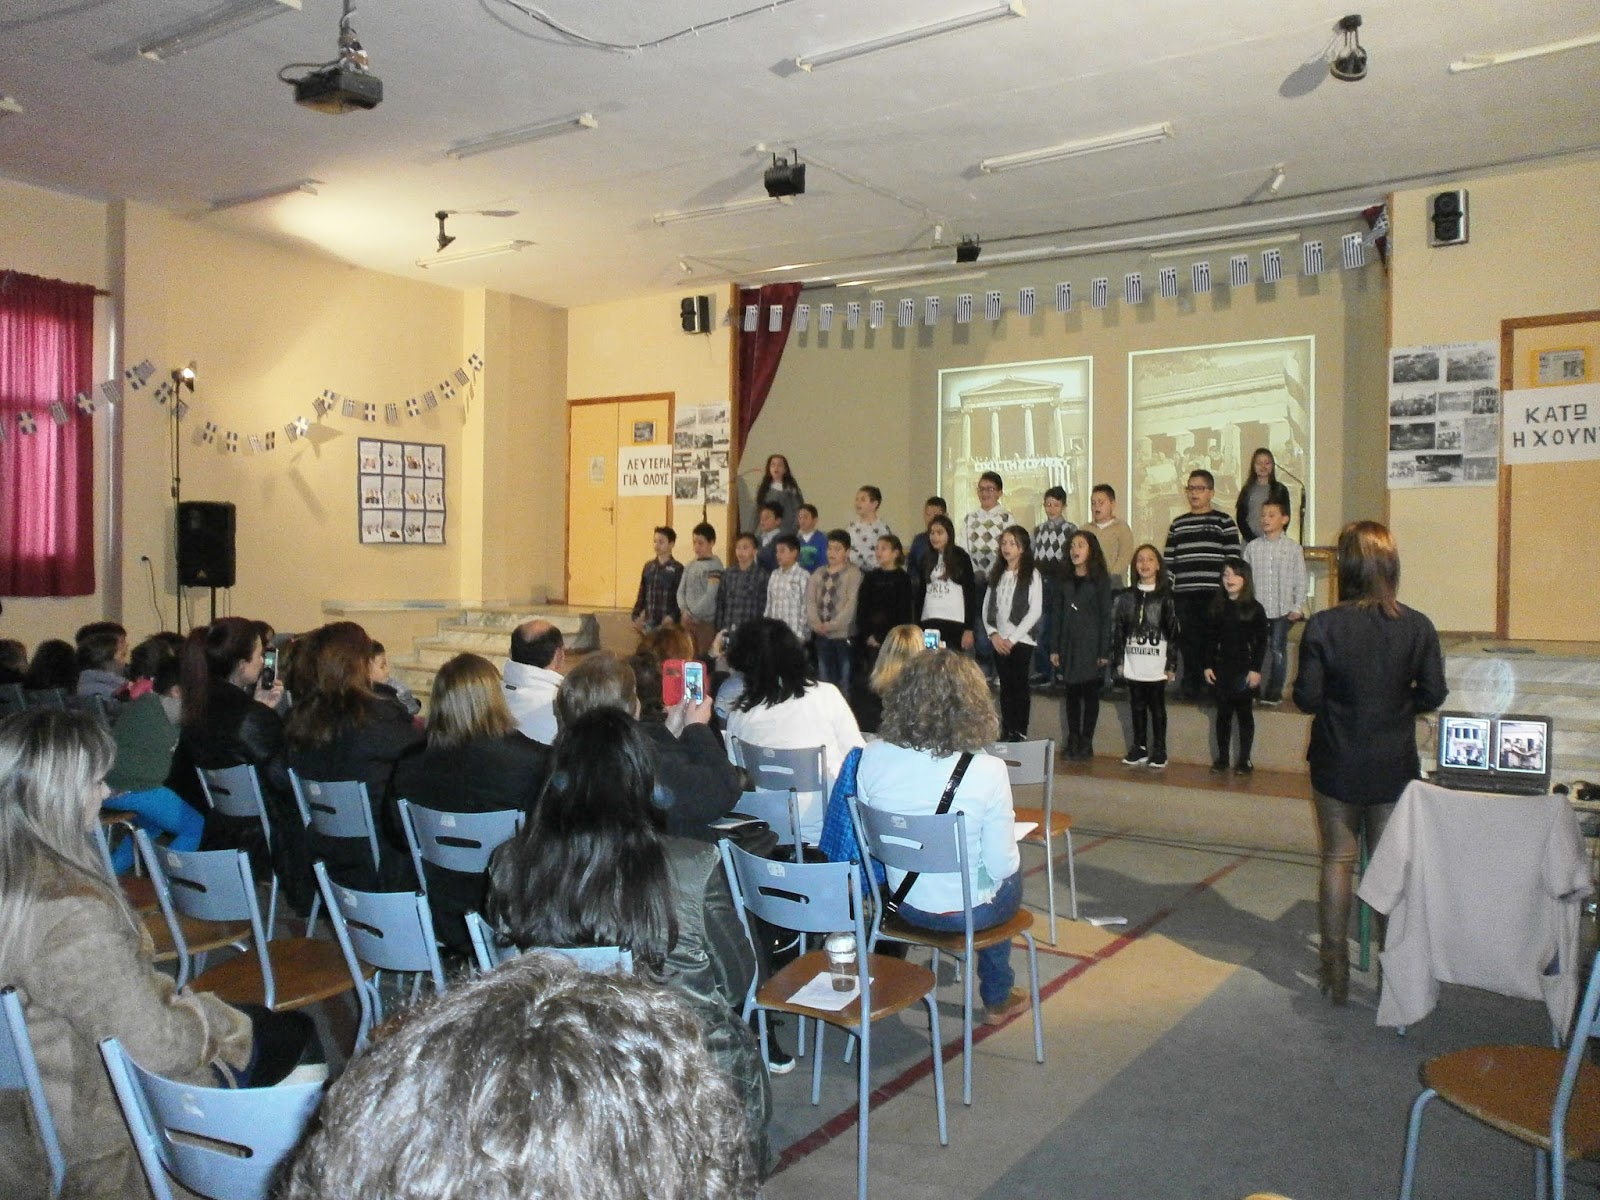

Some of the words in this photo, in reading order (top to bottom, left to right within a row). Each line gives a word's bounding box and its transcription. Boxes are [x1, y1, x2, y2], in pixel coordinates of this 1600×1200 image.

[1525, 404, 1587, 424] ΚΑΤΩ
[1533, 426, 1600, 447] ΧΟΥΝ
[627, 457, 671, 470] ΛΕΥΤΕΡΙΑ
[623, 473, 638, 486] ΓΙΑ
[643, 472, 668, 486] ΟΛΟΥΣ
